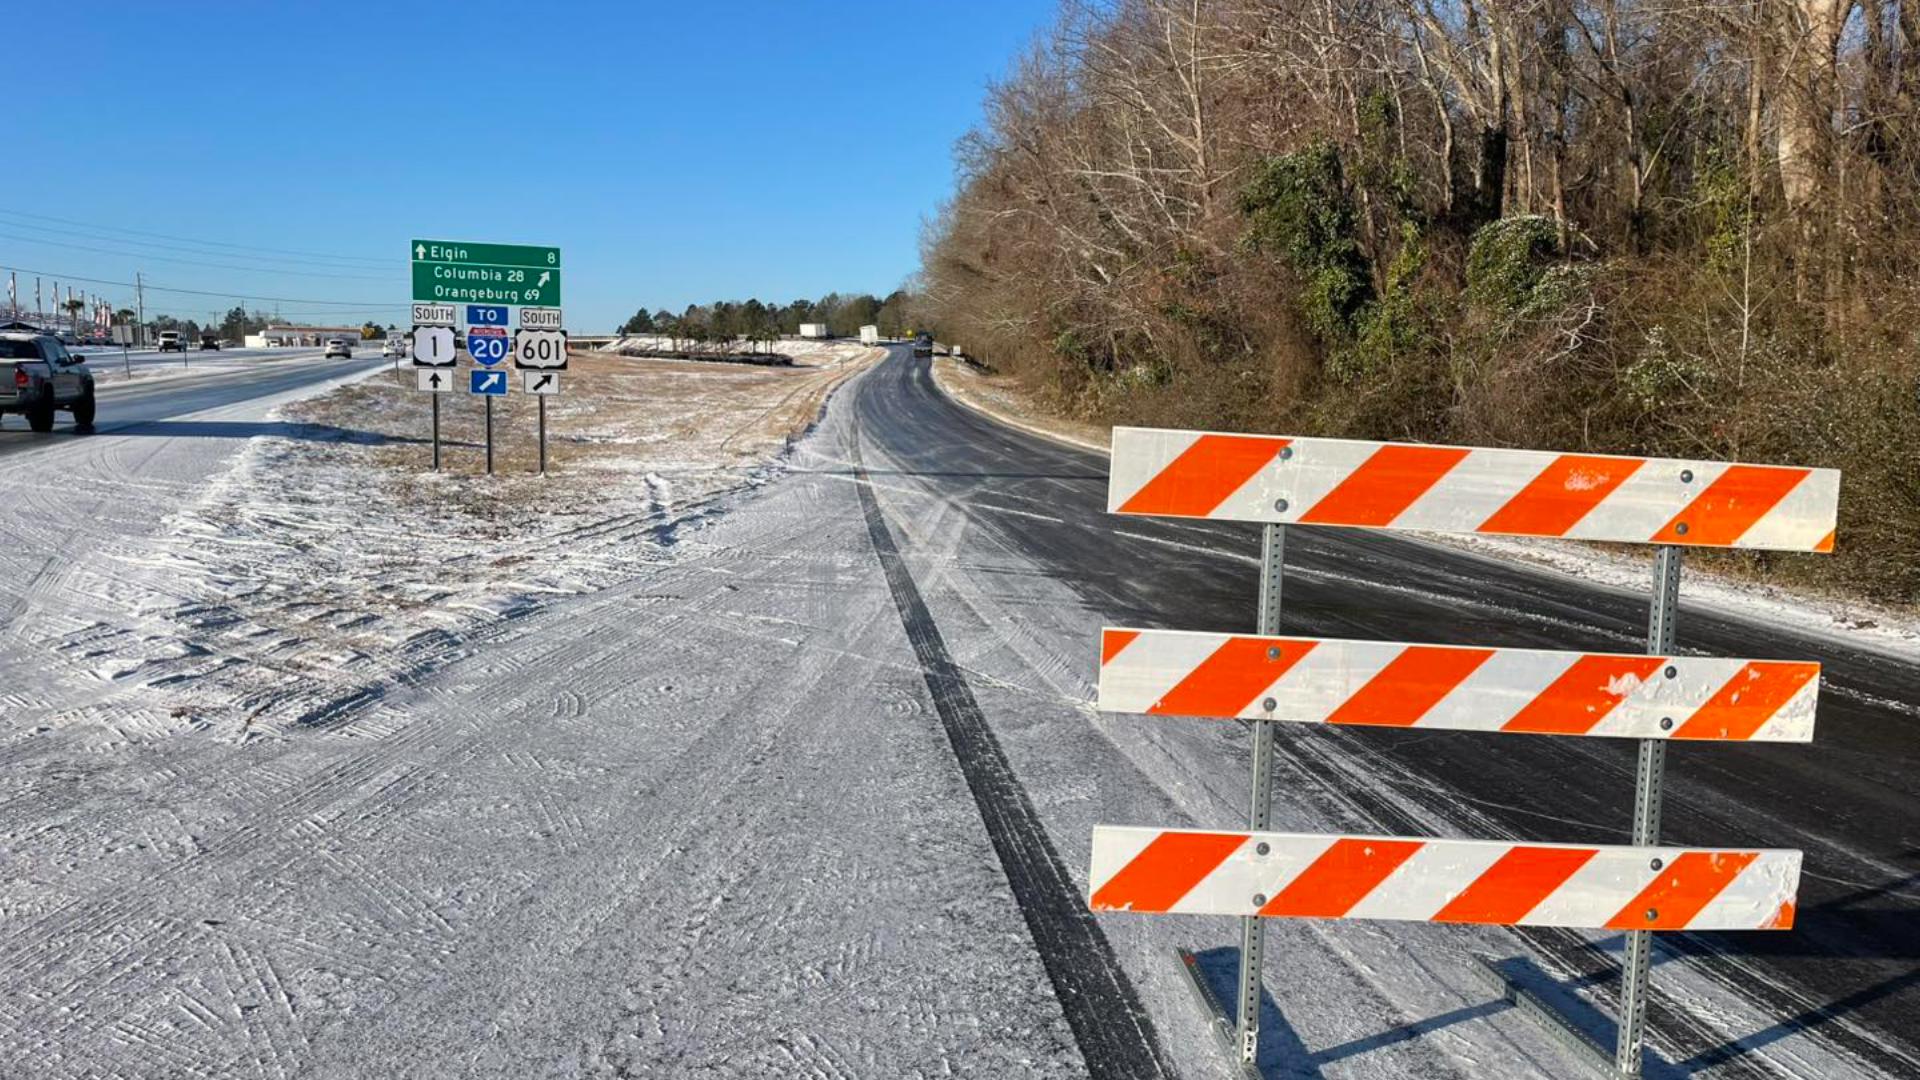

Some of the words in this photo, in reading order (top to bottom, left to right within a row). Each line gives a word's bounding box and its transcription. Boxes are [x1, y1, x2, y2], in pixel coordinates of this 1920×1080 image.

[430, 246, 468, 261] Elgin
[547, 252, 556, 264] 8
[434, 266, 502, 281] Columbia
[507, 270, 524, 282] 28
[434, 285, 518, 302] Orangeburg
[524, 289, 540, 301] 69
[415, 307, 454, 321] SOUTH
[477, 309, 497, 321] TO
[522, 311, 560, 325] SOUTH
[431, 335, 438, 357] 1
[474, 339, 503, 358] 20
[523, 338, 560, 360] 601
